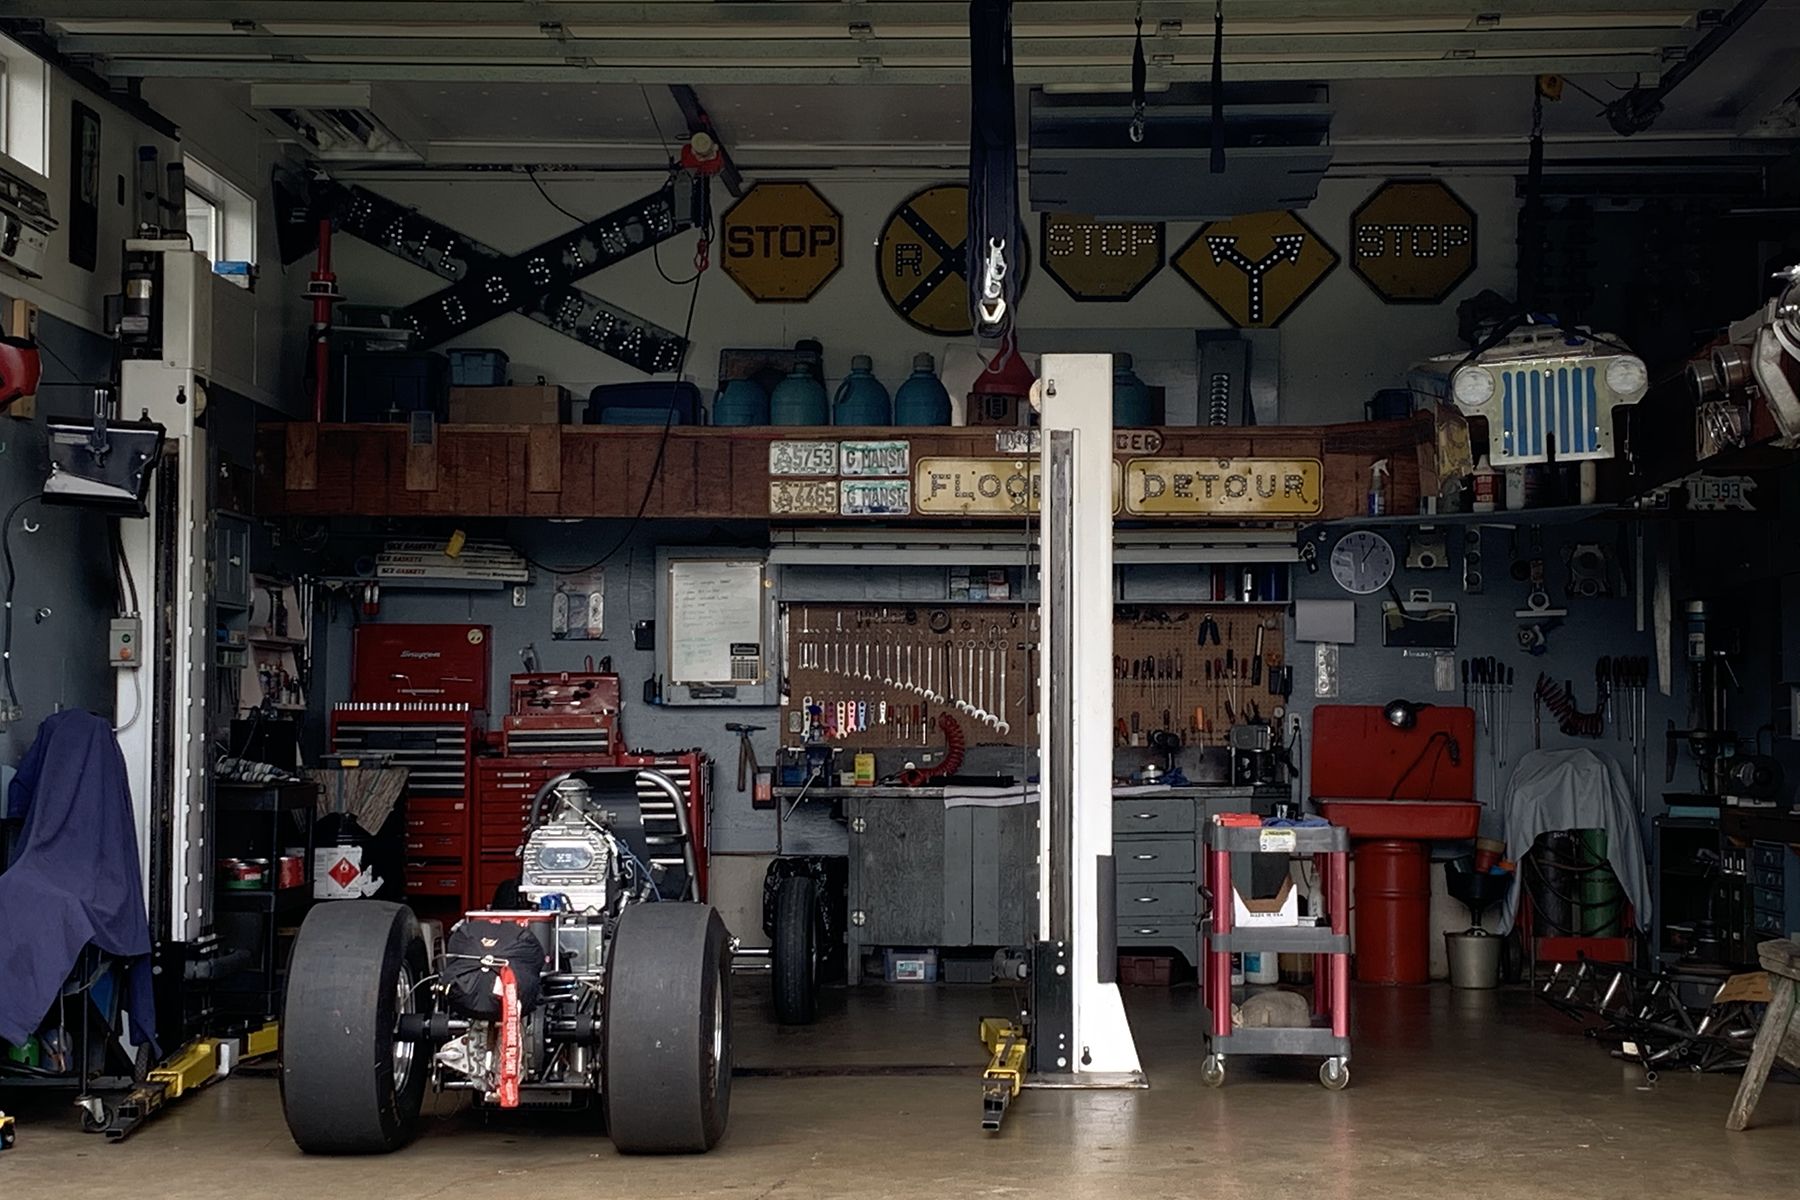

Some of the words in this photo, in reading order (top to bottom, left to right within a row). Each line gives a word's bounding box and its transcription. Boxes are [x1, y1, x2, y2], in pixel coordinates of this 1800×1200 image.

[728, 224, 836, 258] STOP
[1048, 222, 1158, 257] STOP
[1357, 223, 1470, 258] STOP
[895, 243, 922, 277] R
[346, 195, 459, 273] RAIL
[556, 295, 679, 371] ROAD
[1143, 473, 1305, 499] DETOUR
[506, 1016, 517, 1047] BEFORE
